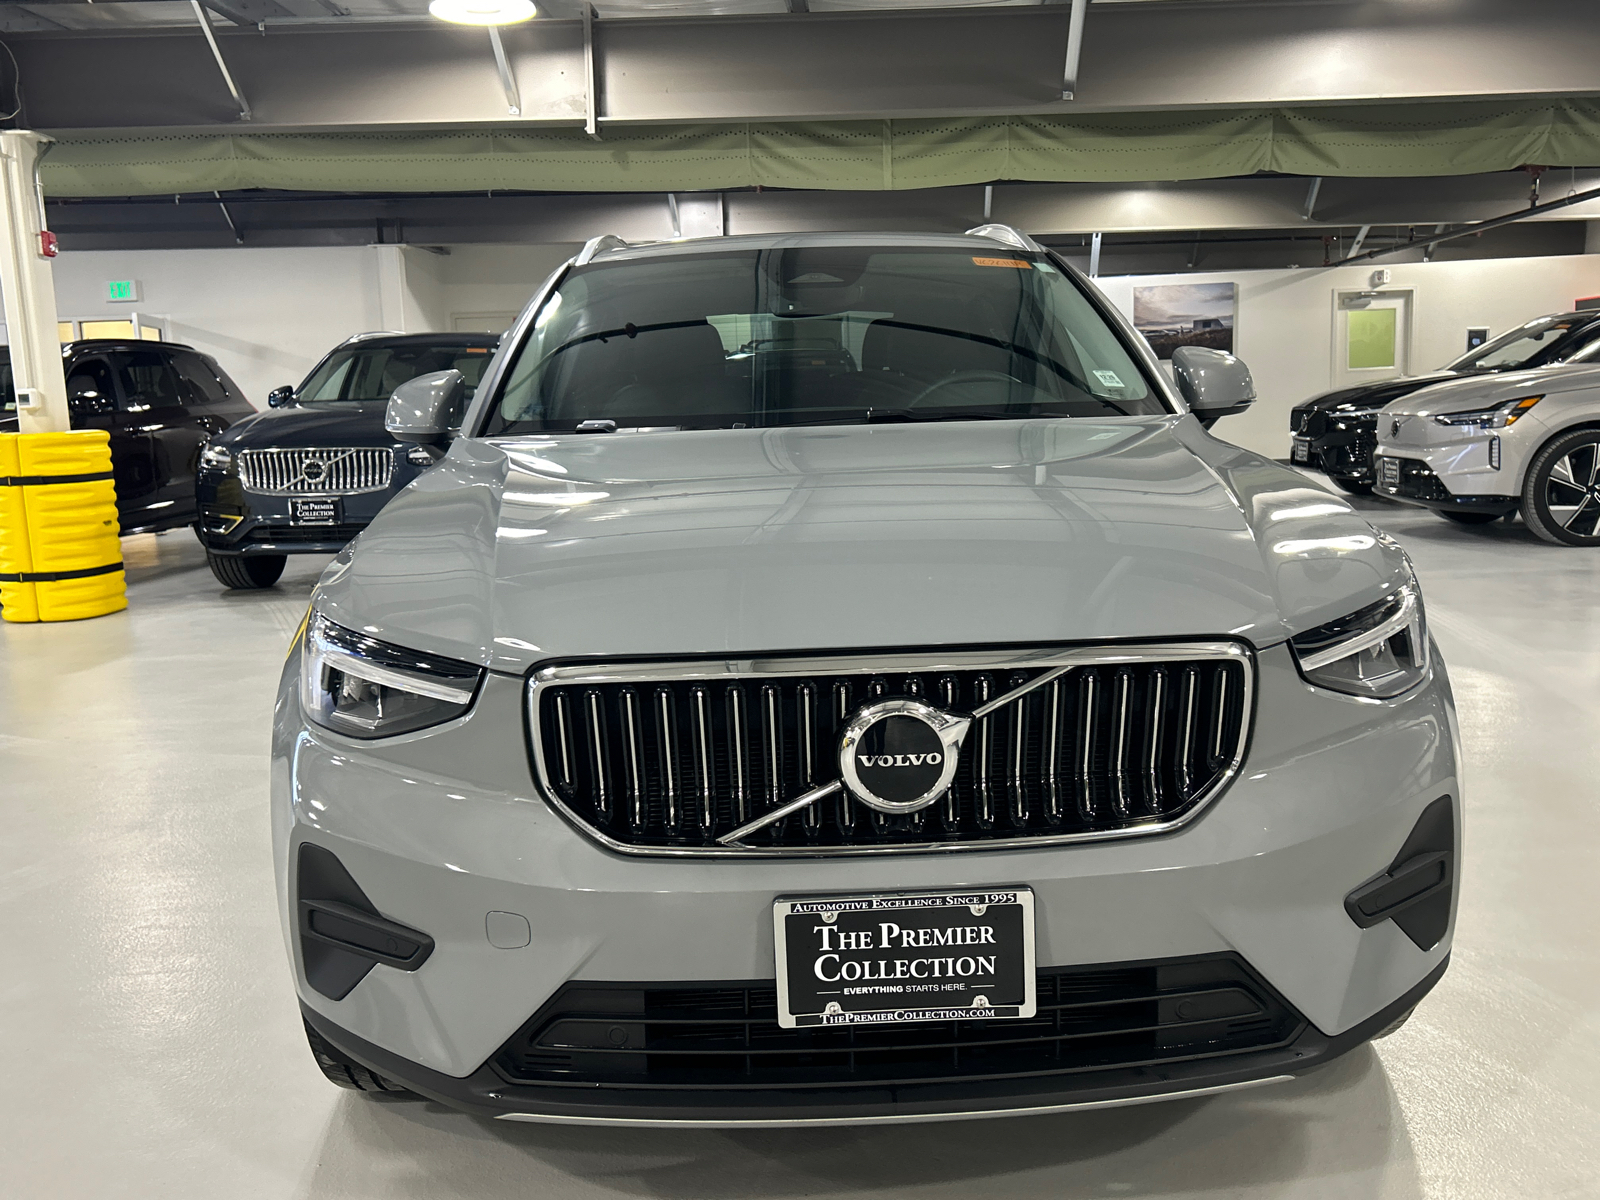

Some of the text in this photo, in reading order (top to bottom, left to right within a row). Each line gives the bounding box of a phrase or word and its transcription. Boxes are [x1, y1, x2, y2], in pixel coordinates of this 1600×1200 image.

[109, 281, 131, 299] EXIT
[296, 509, 335, 517] COLLECTION
[857, 752, 942, 768] VOLVO
[793, 893, 1015, 913] AUTOMOTIVE EXCELLENCE SINCE 1995
[813, 922, 997, 951] THE PREMIER
[813, 954, 997, 982] COLLECTION
[843, 983, 968, 995] EVERYTHING STARTS HERE.
